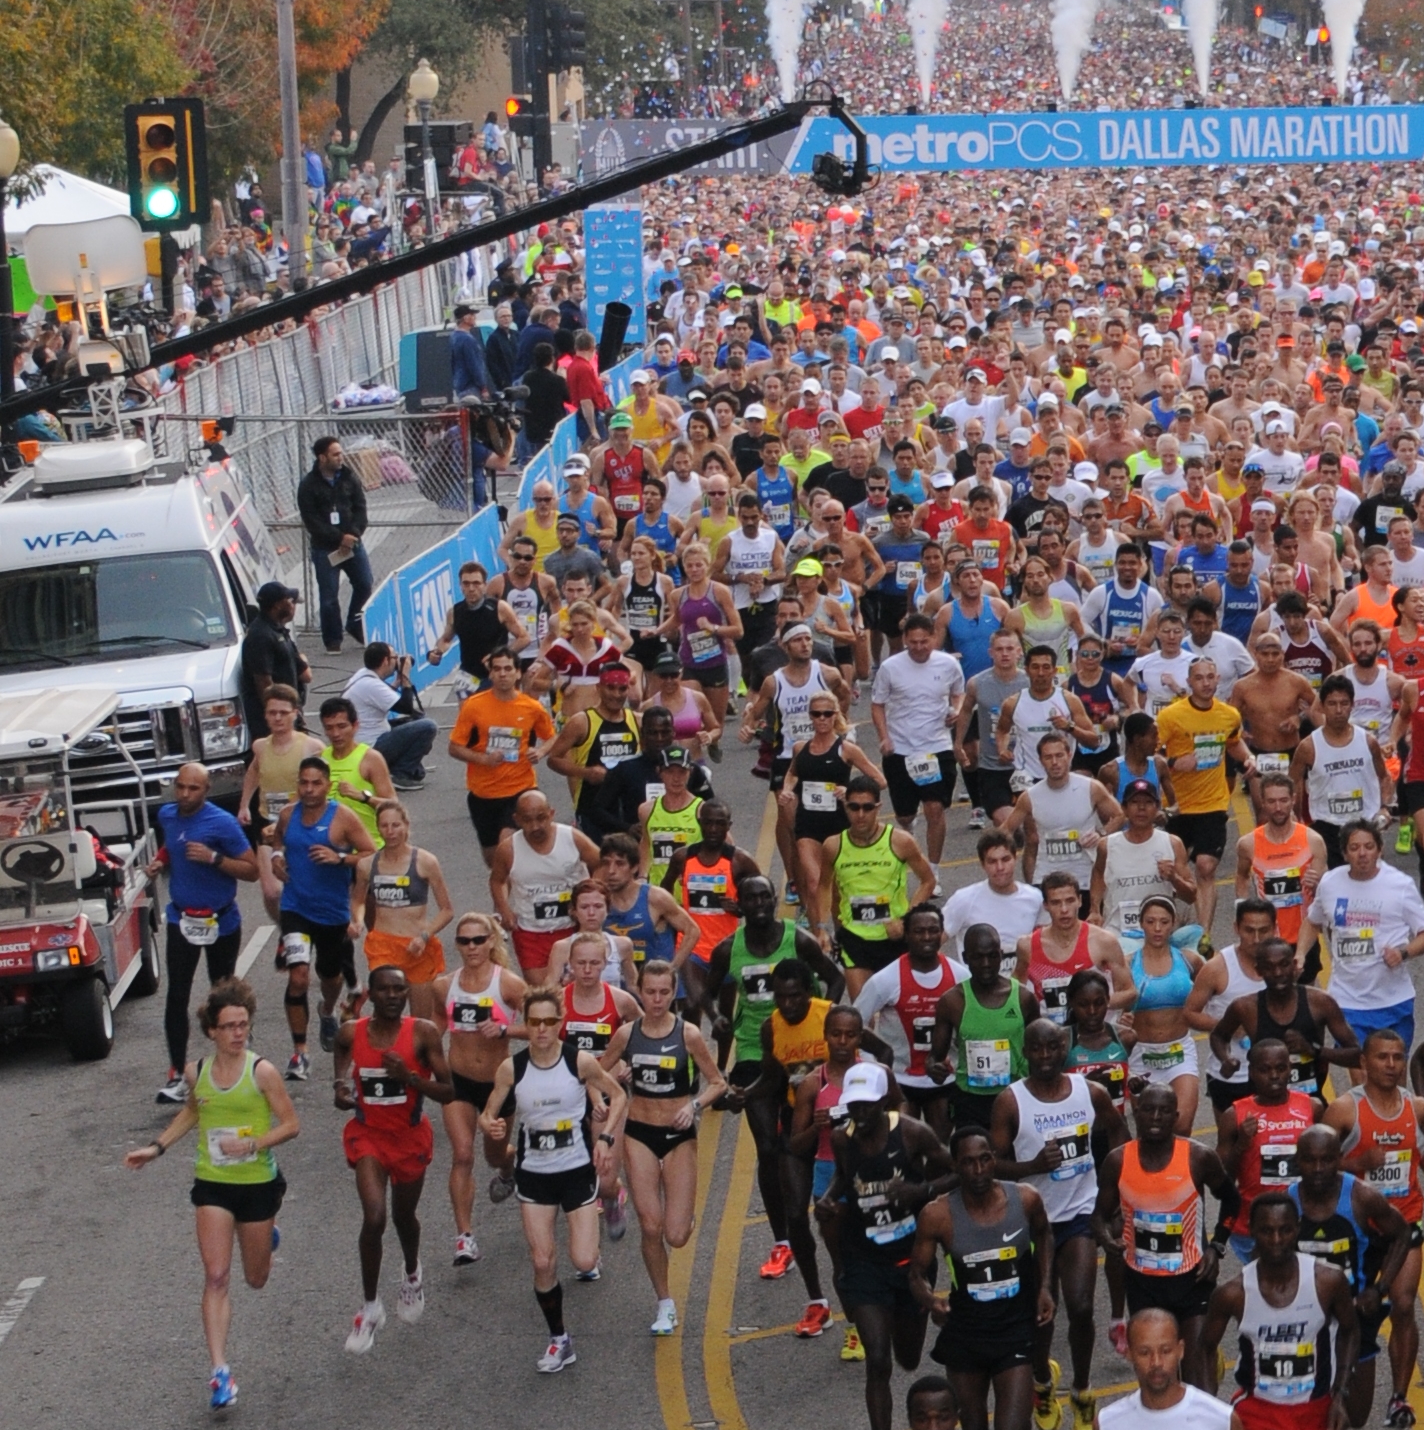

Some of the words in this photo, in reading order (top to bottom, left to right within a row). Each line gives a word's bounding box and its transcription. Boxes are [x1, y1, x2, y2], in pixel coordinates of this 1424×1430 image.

[833, 120, 1084, 164] metroPCS
[1099, 116, 1220, 159] DALLAS
[1230, 112, 1409, 157] MARATHON
[23, 528, 146, 551] WFAA.com
[1323, 758, 1365, 772] TORNADOS
[1273, 882, 1286, 894] 17
[700, 895, 708, 907] 4
[544, 905, 559, 918] 27
[862, 908, 876, 920] 20
[757, 978, 767, 992] 2
[577, 1036, 594, 1050] 29
[783, 1042, 825, 1062] JAKE
[977, 1055, 991, 1069] 51
[1034, 1109, 1087, 1125] MARATHON
[1060, 1142, 1077, 1159] 10
[1277, 1161, 1288, 1177] 8
[874, 1209, 893, 1226] 21
[984, 1266, 992, 1282] 1
[1258, 1320, 1309, 1338] FLEET
